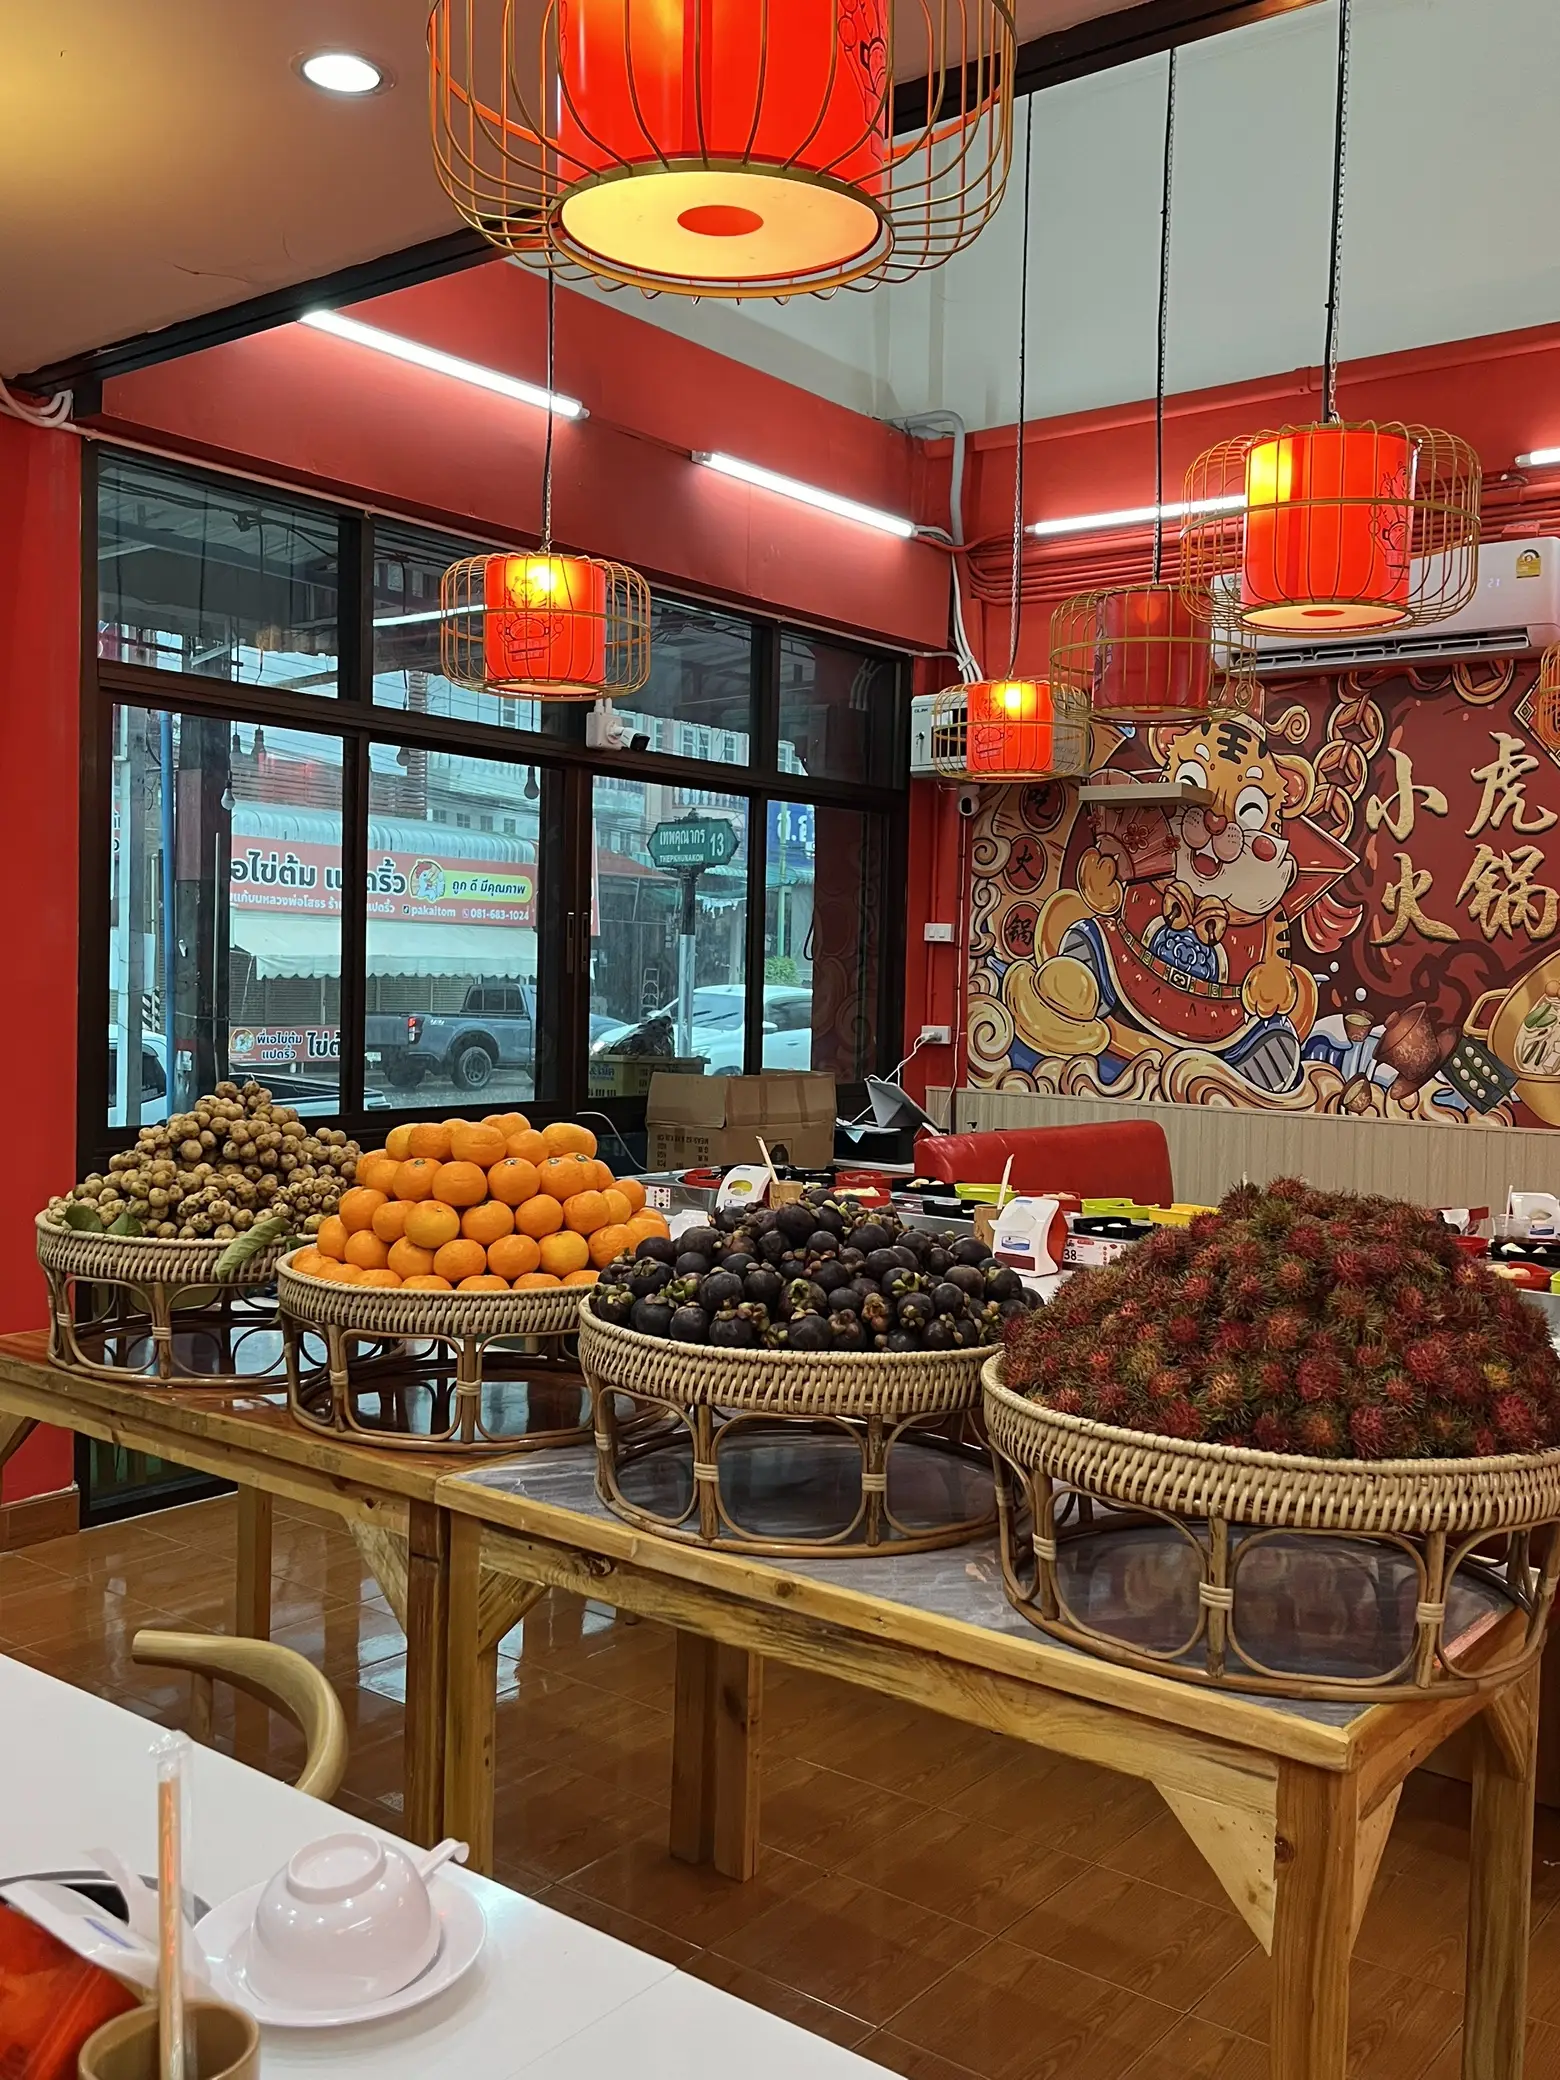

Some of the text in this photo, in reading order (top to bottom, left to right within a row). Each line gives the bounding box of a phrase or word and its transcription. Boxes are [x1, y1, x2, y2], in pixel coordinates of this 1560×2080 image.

[1366, 731, 1558, 842] 小虎
[660, 829, 724, 856] เทพคุณากร 13
[1005, 844, 1037, 882] 火
[452, 879, 526, 896] ถูก ดี มีคุณภาพ
[1369, 844, 1559, 946] 火锅
